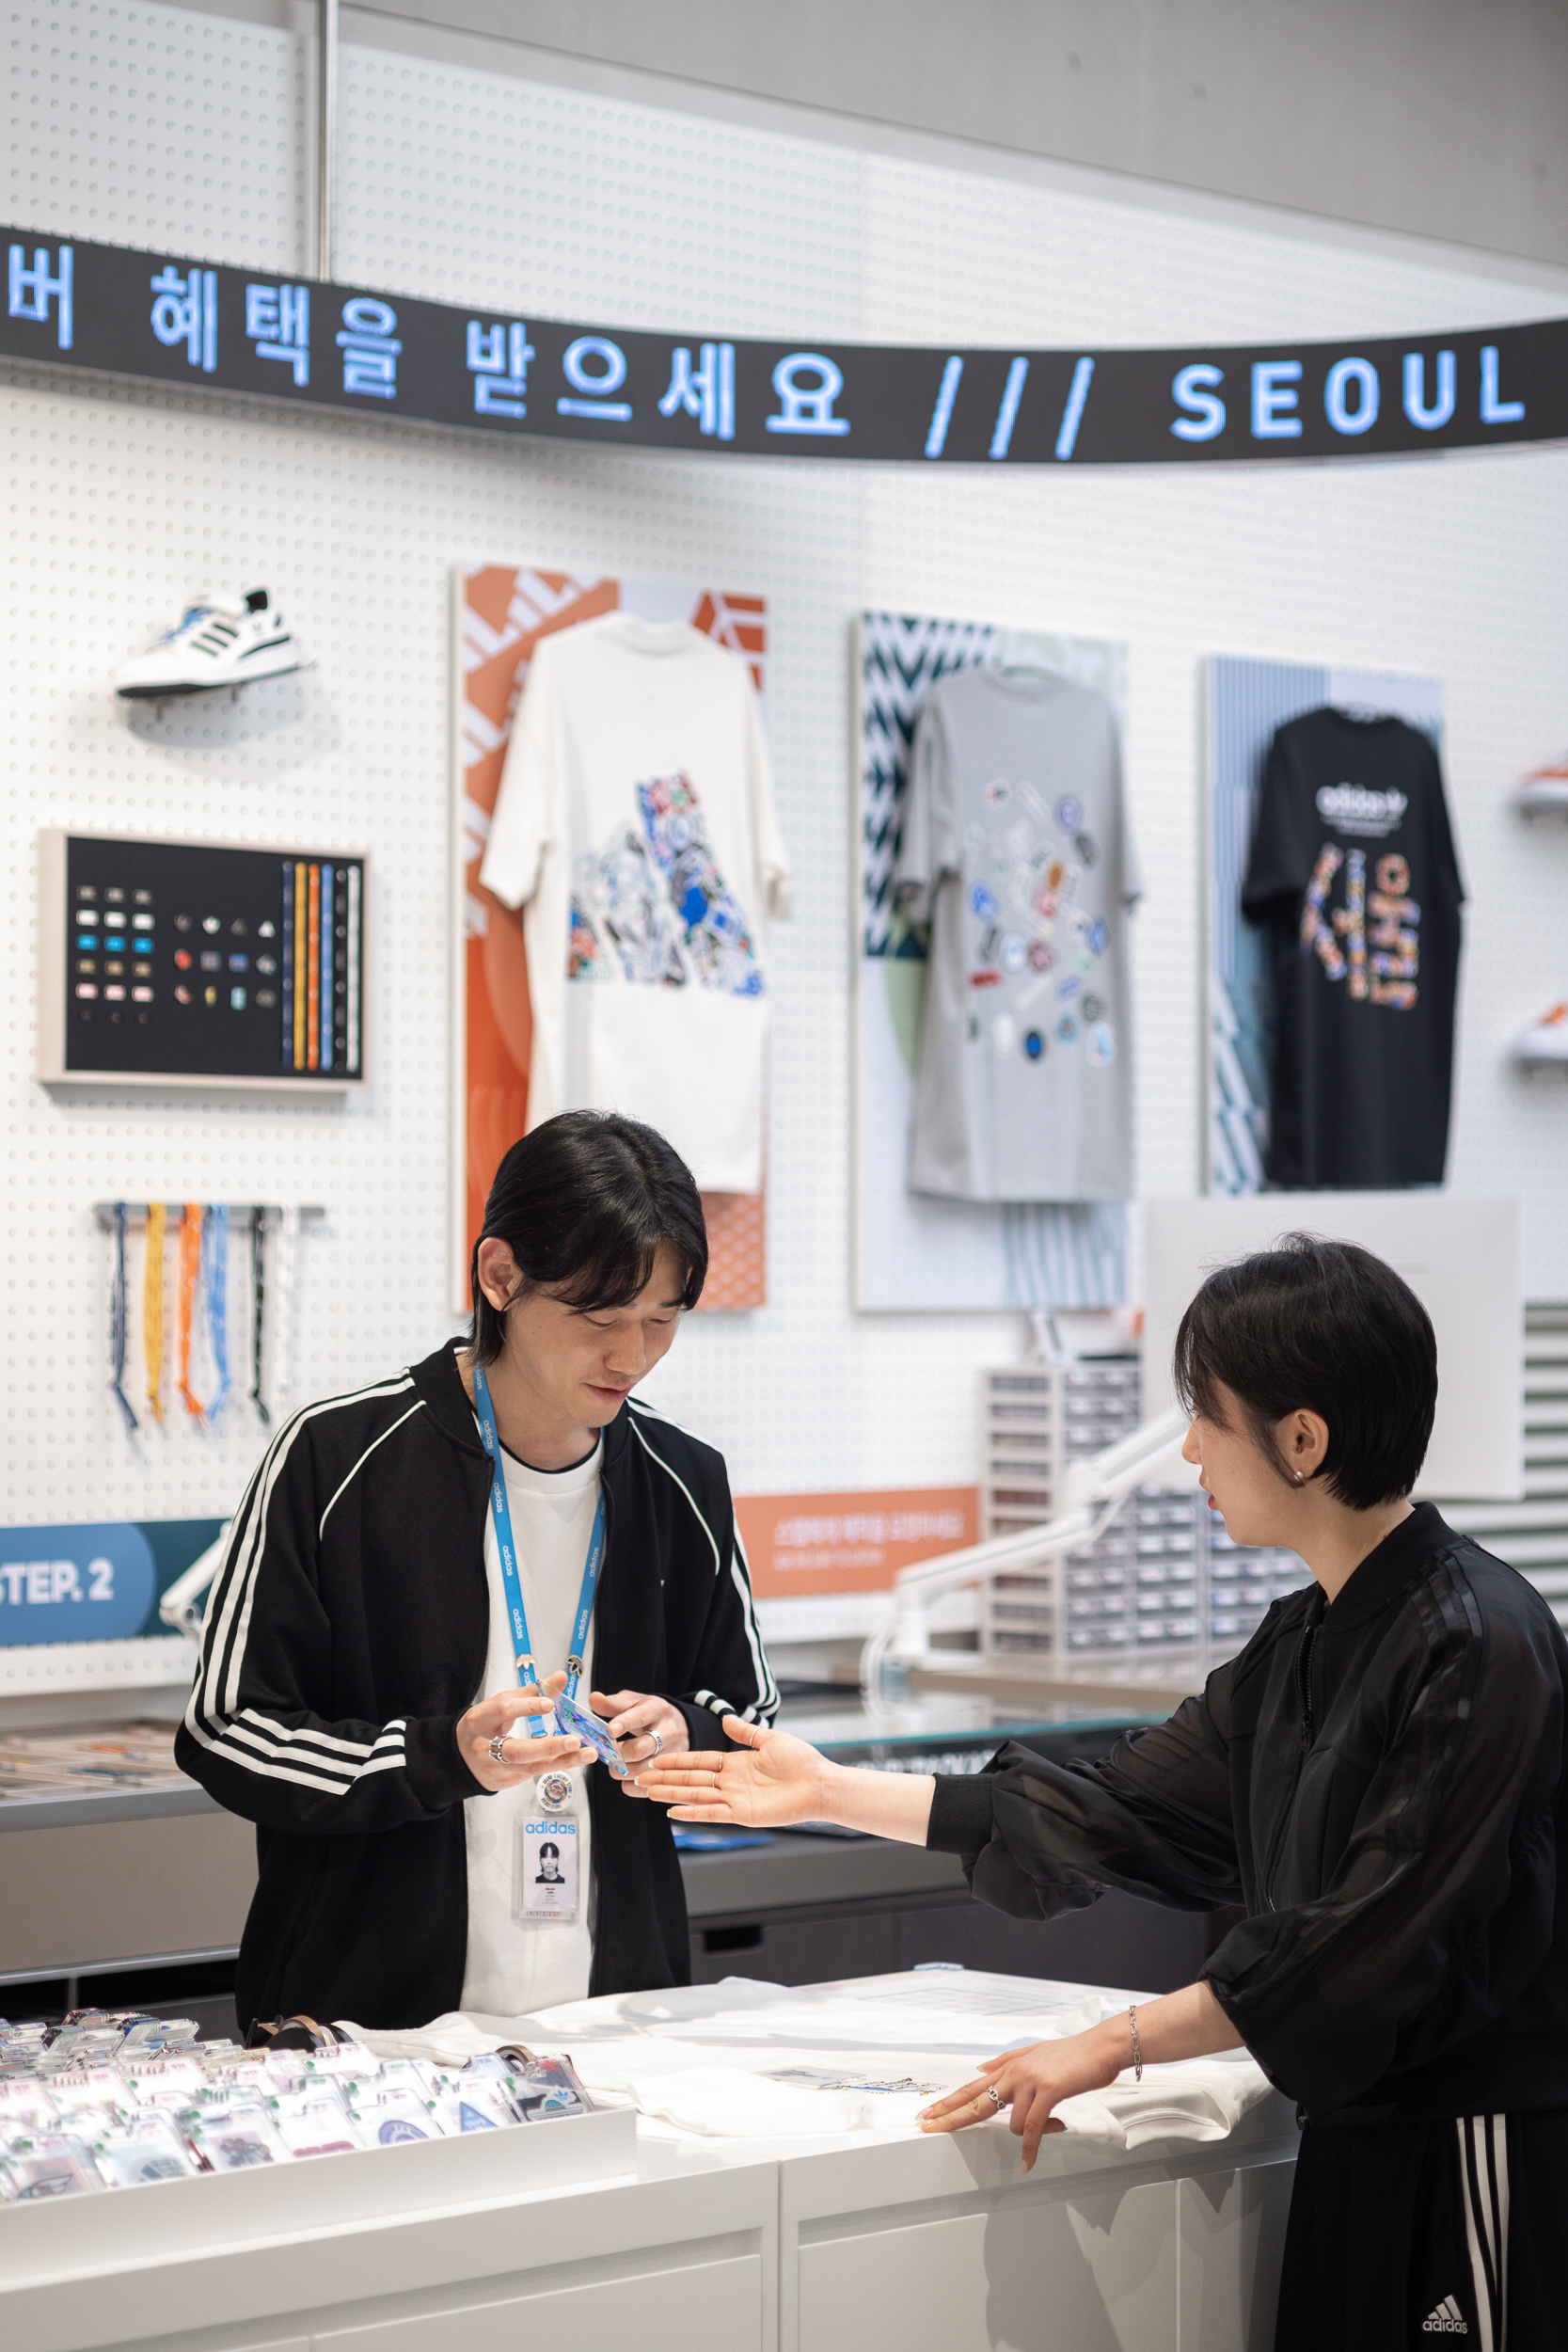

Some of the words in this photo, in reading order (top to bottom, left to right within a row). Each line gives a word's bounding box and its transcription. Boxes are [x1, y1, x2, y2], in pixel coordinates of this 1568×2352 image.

[8, 243, 75, 352] 버
[150, 264, 404, 400] 혜택을
[466, 319, 851, 441] 받으세요
[1169, 345, 1526, 443] SEOUL
[483, 1420, 494, 1450] adidas
[493, 1482, 503, 1514] adidas
[502, 1545, 513, 1577] adidas
[589, 1547, 599, 1578] adidas
[0, 1559, 84, 1605] TEP.
[87, 1557, 115, 1601] 2
[513, 1608, 523, 1640] adidas
[578, 1609, 589, 1640] adidas
[525, 1821, 576, 1835] adidas
[1422, 2317, 1468, 2334] adidas
